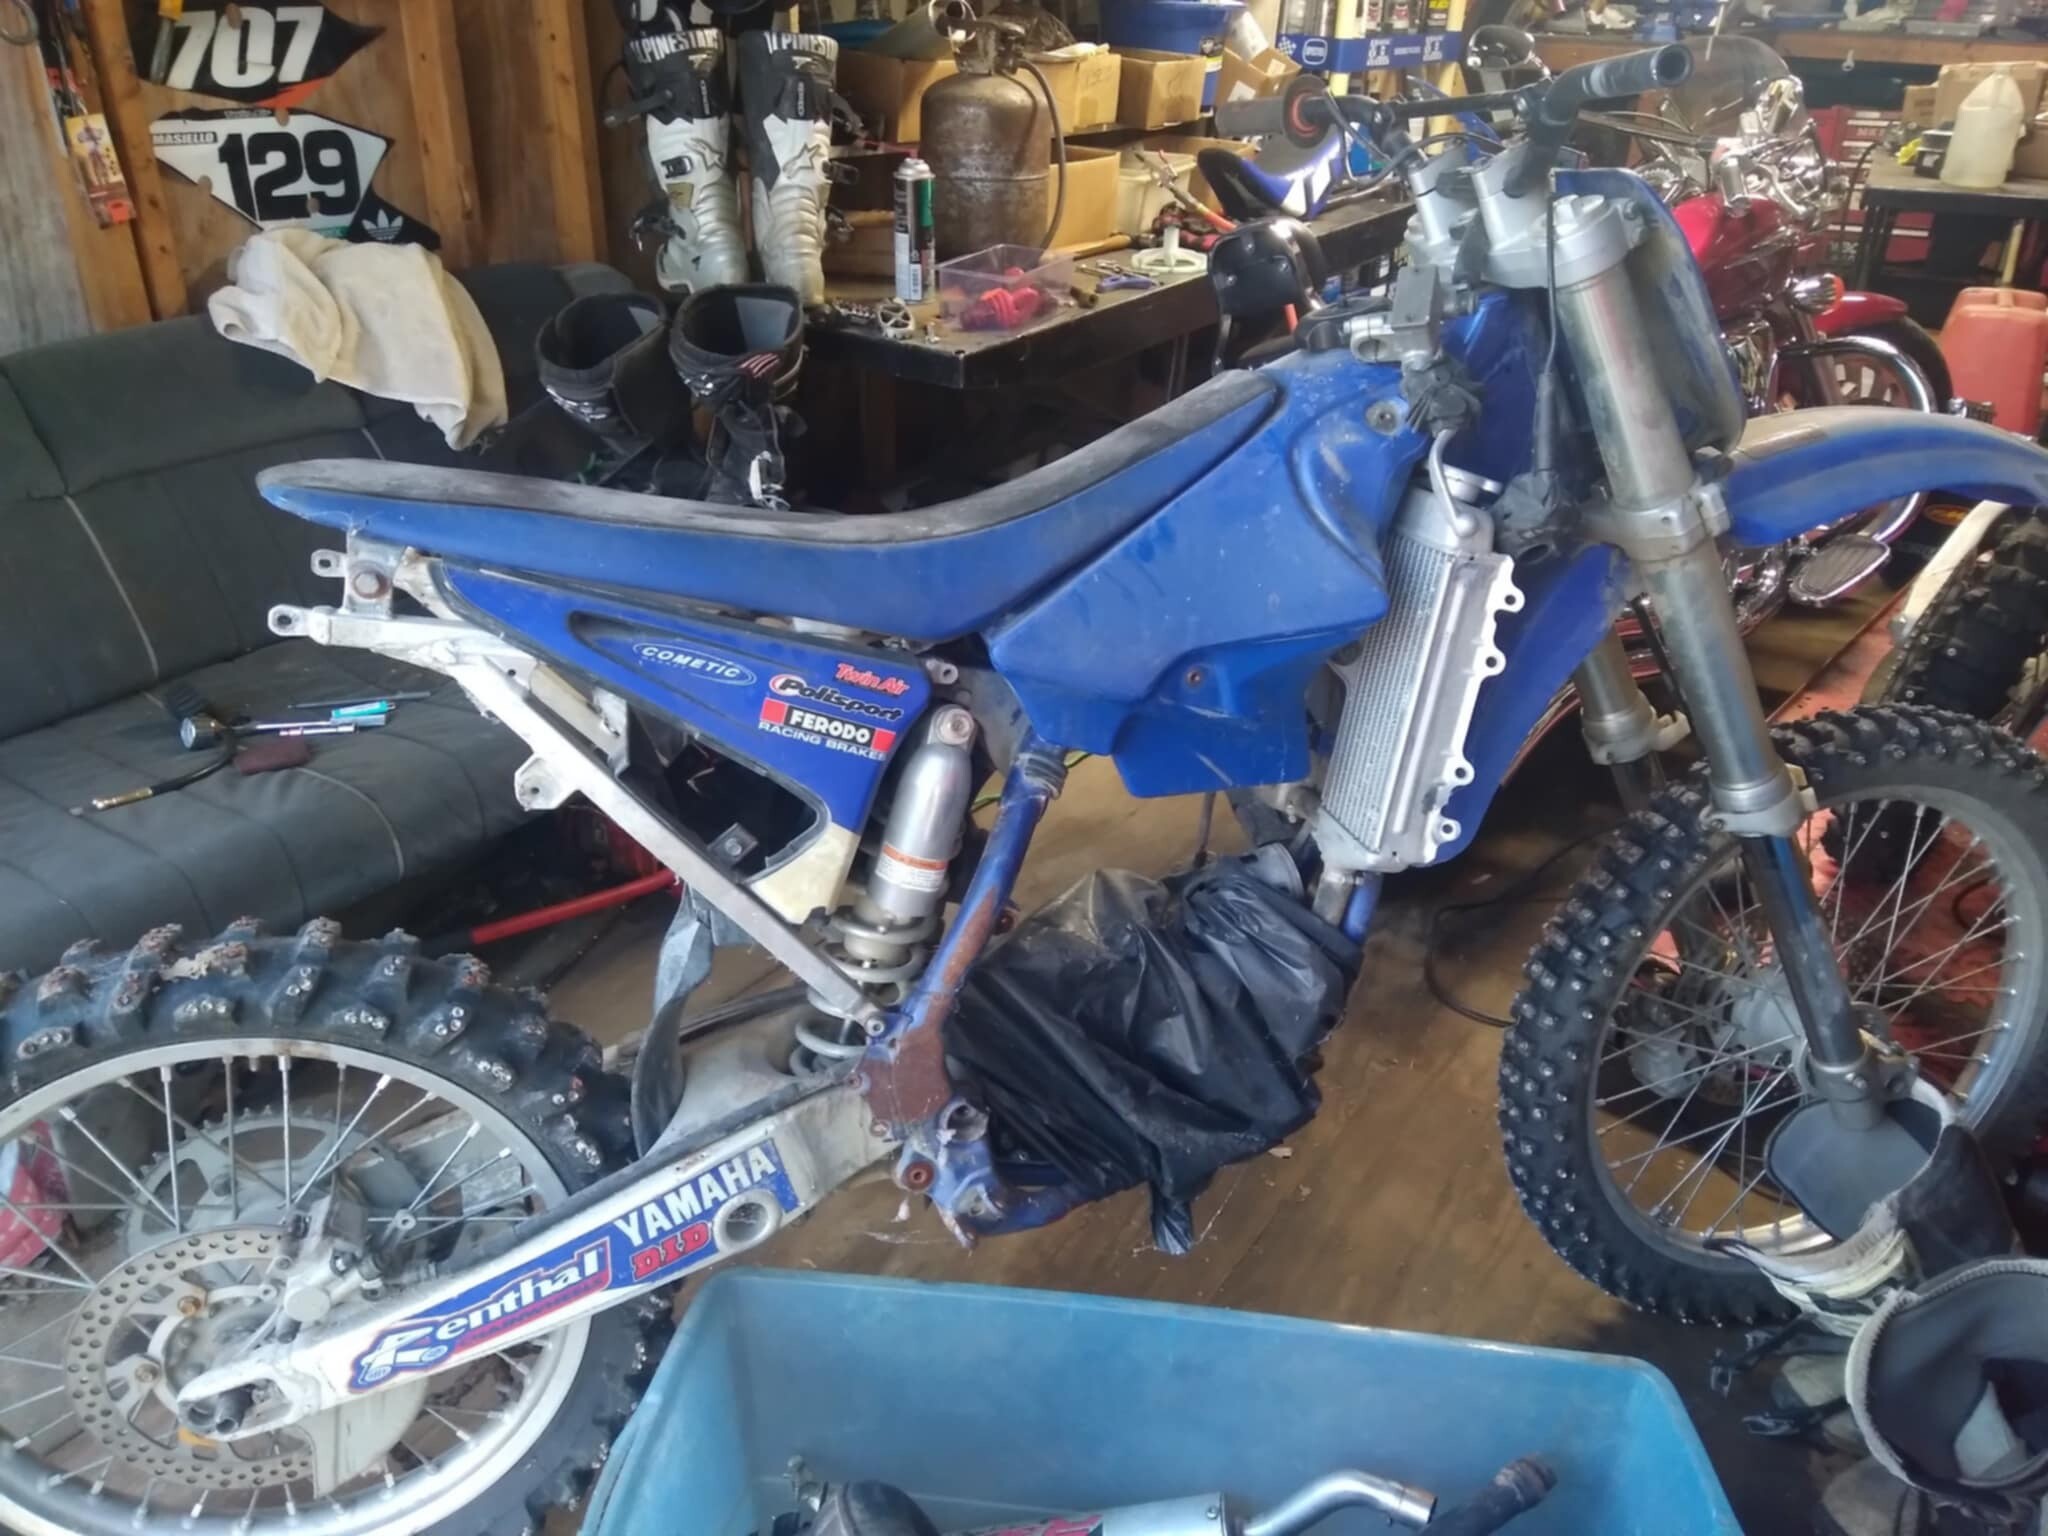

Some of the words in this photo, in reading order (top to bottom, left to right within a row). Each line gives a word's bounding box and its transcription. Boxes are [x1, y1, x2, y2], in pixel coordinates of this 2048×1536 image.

[166, 6, 324, 90] 707
[218, 129, 361, 223] 129
[642, 647, 740, 678] COMETIC
[836, 663, 880, 687] Twin
[878, 677, 909, 696] Air
[778, 677, 903, 721] Polisport
[758, 721, 821, 745] RACING
[790, 709, 871, 743] FERODO
[613, 1146, 776, 1247] YAMAHA
[359, 1249, 599, 1384] Renthal
